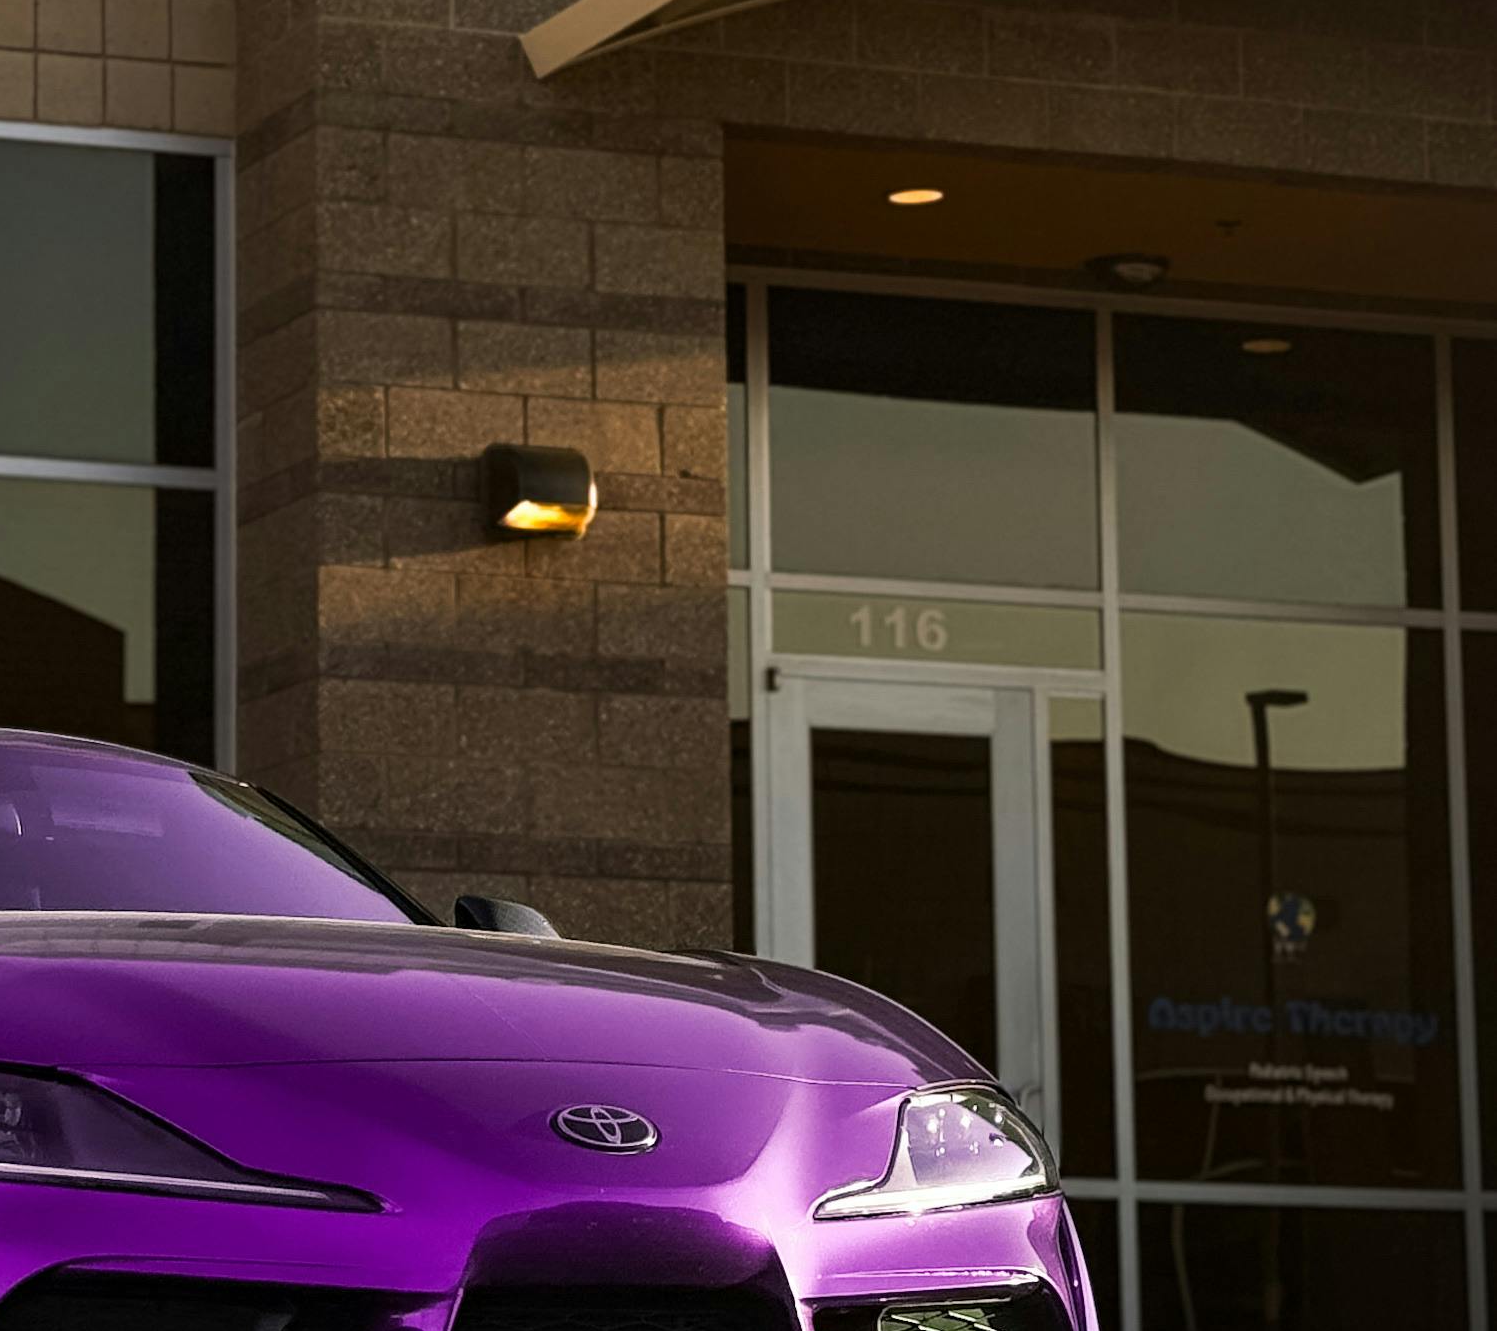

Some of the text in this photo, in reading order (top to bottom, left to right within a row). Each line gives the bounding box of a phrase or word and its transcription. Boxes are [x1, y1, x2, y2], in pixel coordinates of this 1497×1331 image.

[851, 605, 948, 652] 116
[1148, 997, 1439, 1045] Aspire Therapy
[1347, 1088, 1395, 1111] Therapy
